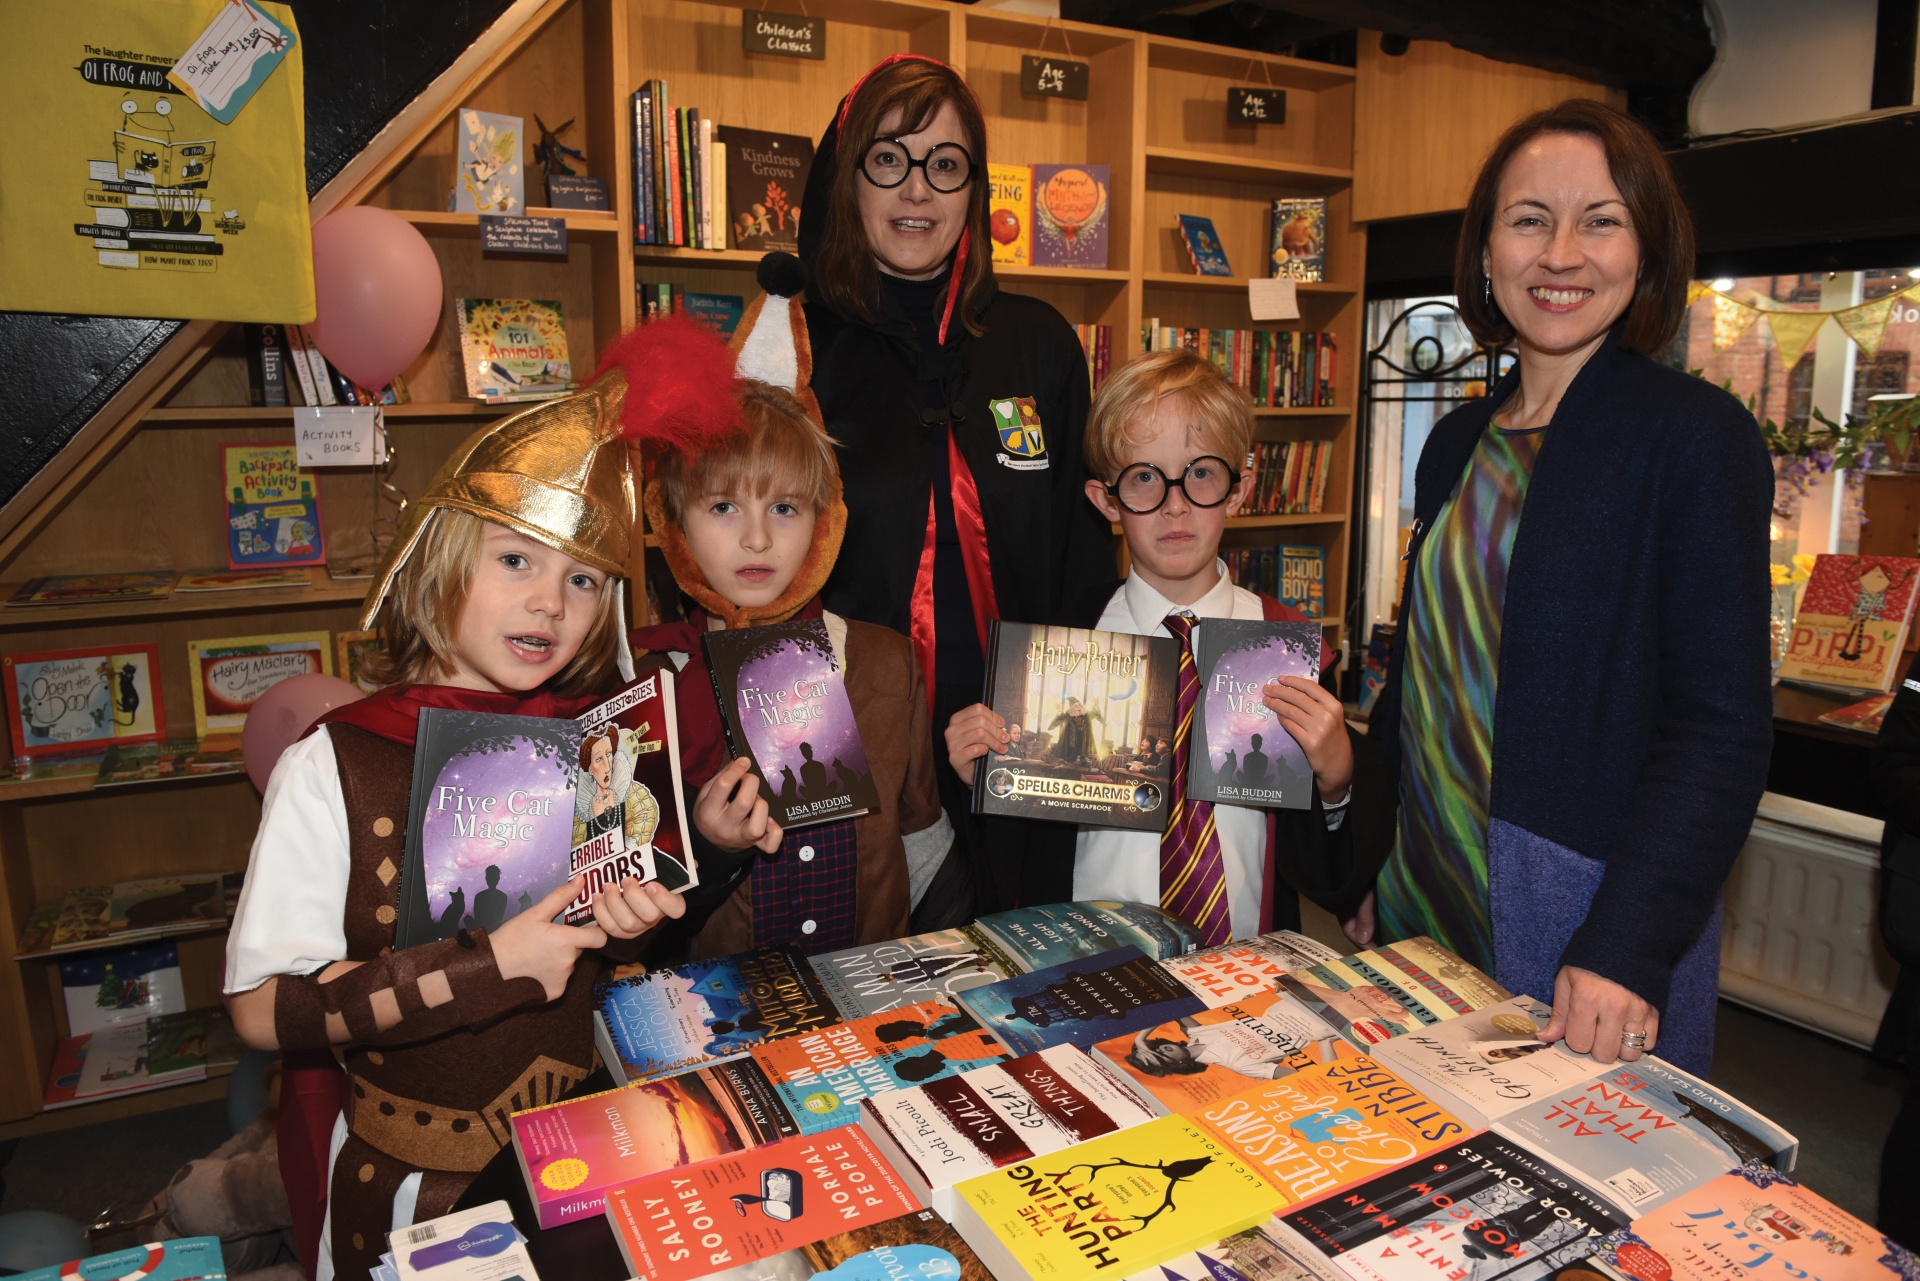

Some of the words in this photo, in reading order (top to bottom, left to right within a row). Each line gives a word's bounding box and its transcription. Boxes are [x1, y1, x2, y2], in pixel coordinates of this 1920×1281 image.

[757, 22, 811, 40] Children's
[84, 44, 101, 55] The
[103, 47, 143, 61] laughter
[146, 55, 173, 64] never
[197, 46, 216, 65] frog
[767, 38, 812, 53] Classics
[201, 59, 219, 76] Tote
[219, 41, 238, 56] bag
[140, 70, 163, 86] AND
[1038, 79, 1063, 92] 5-8
[1042, 63, 1066, 83] Age
[1245, 95, 1265, 108] Age
[741, 148, 800, 168] Kindness
[752, 162, 795, 179] Grows
[215, 222, 246, 230] BOOKSHOP
[504, 217, 530, 226] SPRING
[691, 297, 714, 308] Judith
[509, 332, 529, 344] 101
[262, 325, 280, 381] Collins
[488, 342, 555, 361] Animals
[302, 430, 353, 441] ACTIVITY
[323, 442, 361, 454] BOOKS
[239, 460, 298, 476] Backpack
[244, 474, 297, 491] Activity
[257, 487, 283, 499] Book
[1282, 558, 1323, 580] RADIO
[1282, 578, 1311, 600] BOY
[212, 661, 249, 691] Hairy
[253, 655, 307, 674] Maclary
[1026, 640, 1081, 677] Harry
[1084, 641, 1142, 684] Potter
[32, 677, 72, 700] Open
[75, 675, 91, 689] the
[740, 687, 787, 709] Five
[793, 679, 830, 699] Cat
[1214, 674, 1258, 695] Five
[759, 701, 824, 729] Magic
[436, 786, 497, 813] Five
[507, 790, 553, 817] Cat
[1017, 778, 1060, 794] SPELLS
[1062, 785, 1070, 795] &
[1072, 784, 1131, 801] CHARMS
[1217, 785, 1239, 796] LISA
[1242, 788, 1282, 799] BUDDIN
[786, 804, 810, 817] LISA
[811, 794, 852, 812] BUDDIN
[1048, 800, 1069, 808] MOVIE
[1071, 802, 1112, 812] SCRAPBOOK
[451, 812, 534, 849] Magic
[1008, 923, 1030, 938] THE
[1058, 921, 1077, 934] WE
[1067, 911, 1108, 938] CANNOT
[1096, 913, 1118, 925] SEE
[1027, 936, 1048, 950] ALL
[1032, 922, 1064, 943] LIGHT
[1425, 946, 1459, 969] MORRIS
[1179, 965, 1235, 998] THE
[1199, 953, 1278, 997] LONG
[1379, 948, 1476, 1015] AUSCHWITZ
[1401, 981, 1418, 991] OF
[1459, 968, 1498, 997] HEATHER
[741, 960, 798, 1038] MITFORD
[760, 951, 826, 1026] MURDERS
[1072, 975, 1120, 1016] BETWEEN
[1100, 971, 1142, 1006] OCEANS
[1350, 960, 1438, 1026] tattooist
[1363, 987, 1391, 1004] THE
[1027, 1004, 1043, 1019] The
[1054, 988, 1088, 1017] LIGHT
[622, 997, 657, 1052] JESSICA
[638, 984, 682, 1058] FELLOWES
[1219, 1028, 1263, 1061] Christine
[1222, 1005, 1318, 1073] Tangerine
[1232, 1027, 1272, 1056] Mangan
[797, 1034, 868, 1107] AMERICAN
[826, 1026, 902, 1097] MARRIAGE
[1408, 1036, 1532, 1099] GOLDFINCH
[726, 1069, 751, 1096] BURNS
[786, 1066, 822, 1088] AN
[1613, 1073, 1649, 1092] IS
[1645, 1064, 1693, 1089] SZALAY
[1024, 1069, 1085, 1117] THINGS
[1326, 1066, 1390, 1118] NINA
[1340, 1061, 1463, 1142] STIBBE
[1692, 1087, 1733, 1113] DAVID
[745, 1097, 768, 1124] ANNA
[895, 1099, 937, 1138] Picoult
[948, 1091, 1004, 1142] SMALL
[980, 1084, 1044, 1129] GREAT
[1259, 1100, 1295, 1123] BE
[1586, 1082, 1677, 1130] MAN
[605, 1106, 637, 1158] Milkman
[844, 1125, 860, 1140] AWARD
[1262, 1085, 1417, 1165] Cheerful
[1544, 1104, 1604, 1137] ALL
[1561, 1096, 1647, 1145] THAT
[854, 1139, 870, 1153] NOVEL
[929, 1139, 965, 1165] Jodi
[1181, 1126, 1224, 1157] FOLEY
[1203, 1100, 1340, 1201] REASONS
[573, 1163, 583, 1178] SOLD
[864, 1152, 880, 1166] COSTA
[875, 1165, 887, 1175] 2018
[1316, 1145, 1350, 1174] TO
[1457, 1147, 1535, 1196] TOWLES
[1495, 1145, 1547, 1176] CIVILITY
[548, 1169, 558, 1184] OVER
[564, 1163, 575, 1182] COPIES
[800, 1145, 861, 1220] NORMAL
[825, 1142, 884, 1207] PEOPLE
[881, 1174, 894, 1184] THE
[1226, 1160, 1263, 1189] LUCY
[1549, 1177, 1568, 1189] OF
[619, 1198, 631, 1217] BESTSELLER
[894, 1191, 914, 1211] WINNER
[1043, 1171, 1133, 1242] PARTY
[1571, 1190, 1610, 1217] RULES
[627, 1216, 635, 1225] ONE
[643, 1197, 691, 1262] SALLY
[671, 1178, 732, 1266] ROONEY
[1006, 1164, 1120, 1270] HUNTING
[1017, 1204, 1053, 1238] THE
[1408, 1183, 1529, 1260] MOSCOW
[1540, 1197, 1603, 1238] AMOR
[630, 1224, 642, 1240] NUMBER
[1296, 1216, 1346, 1253] BESTSELLER
[1423, 1221, 1455, 1242] IN
[637, 1240, 646, 1252] TIMES
[1379, 1247, 1400, 1258] A
[642, 1252, 654, 1269] SUNDAY
[1345, 1253, 1370, 1273] TIMES
[649, 1269, 657, 1278] THE
